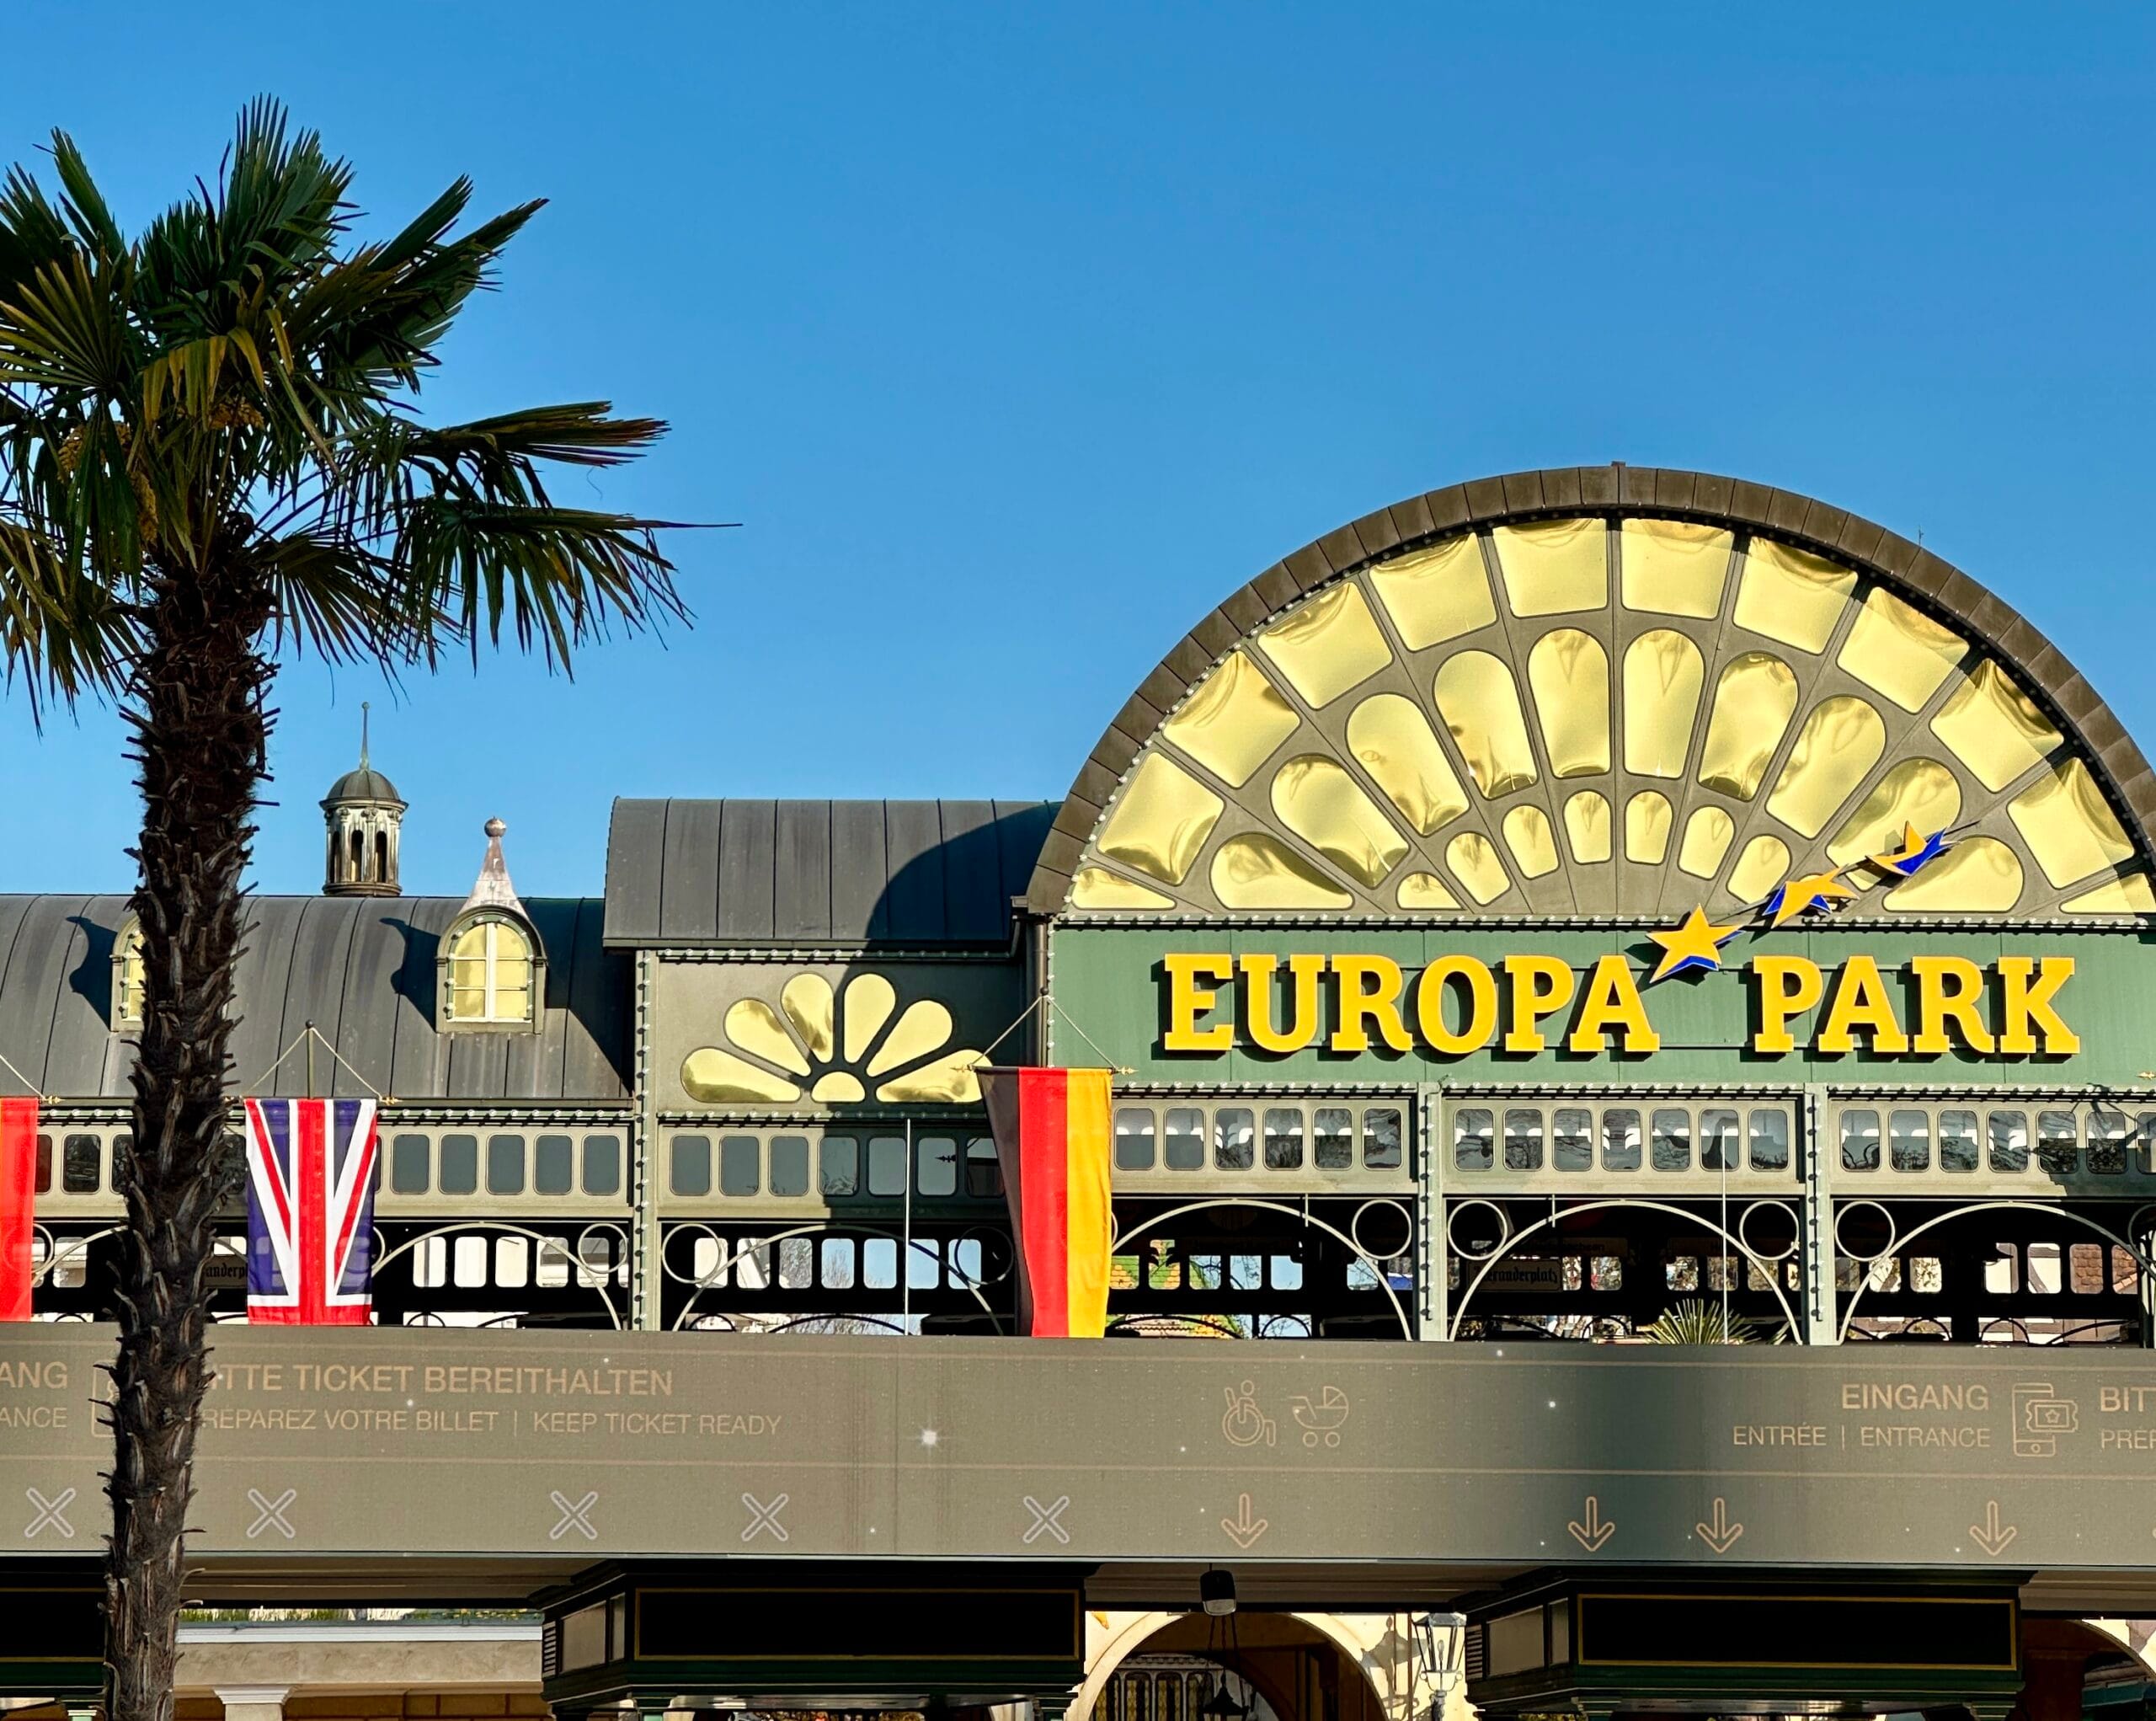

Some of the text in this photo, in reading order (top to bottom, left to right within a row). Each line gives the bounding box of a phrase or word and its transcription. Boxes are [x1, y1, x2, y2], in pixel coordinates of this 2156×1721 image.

[1165, 953, 2080, 1054] EUROPA PARK
[0, 1361, 68, 1389] ANG
[210, 1364, 673, 1395] ITTE TICKET BEREITHALTEN
[1842, 1383, 1989, 1410] EINGANG
[2100, 1387, 2156, 1412] BIT
[0, 1407, 68, 1428] ANCE
[323, 1409, 408, 1430] VOTRE
[416, 1410, 499, 1431] BILLET
[534, 1412, 598, 1433] KEEP
[604, 1413, 691, 1434] TICKET
[699, 1414, 782, 1435] READY
[1733, 1421, 1991, 1448] ENTRÉE ENTRANCE
